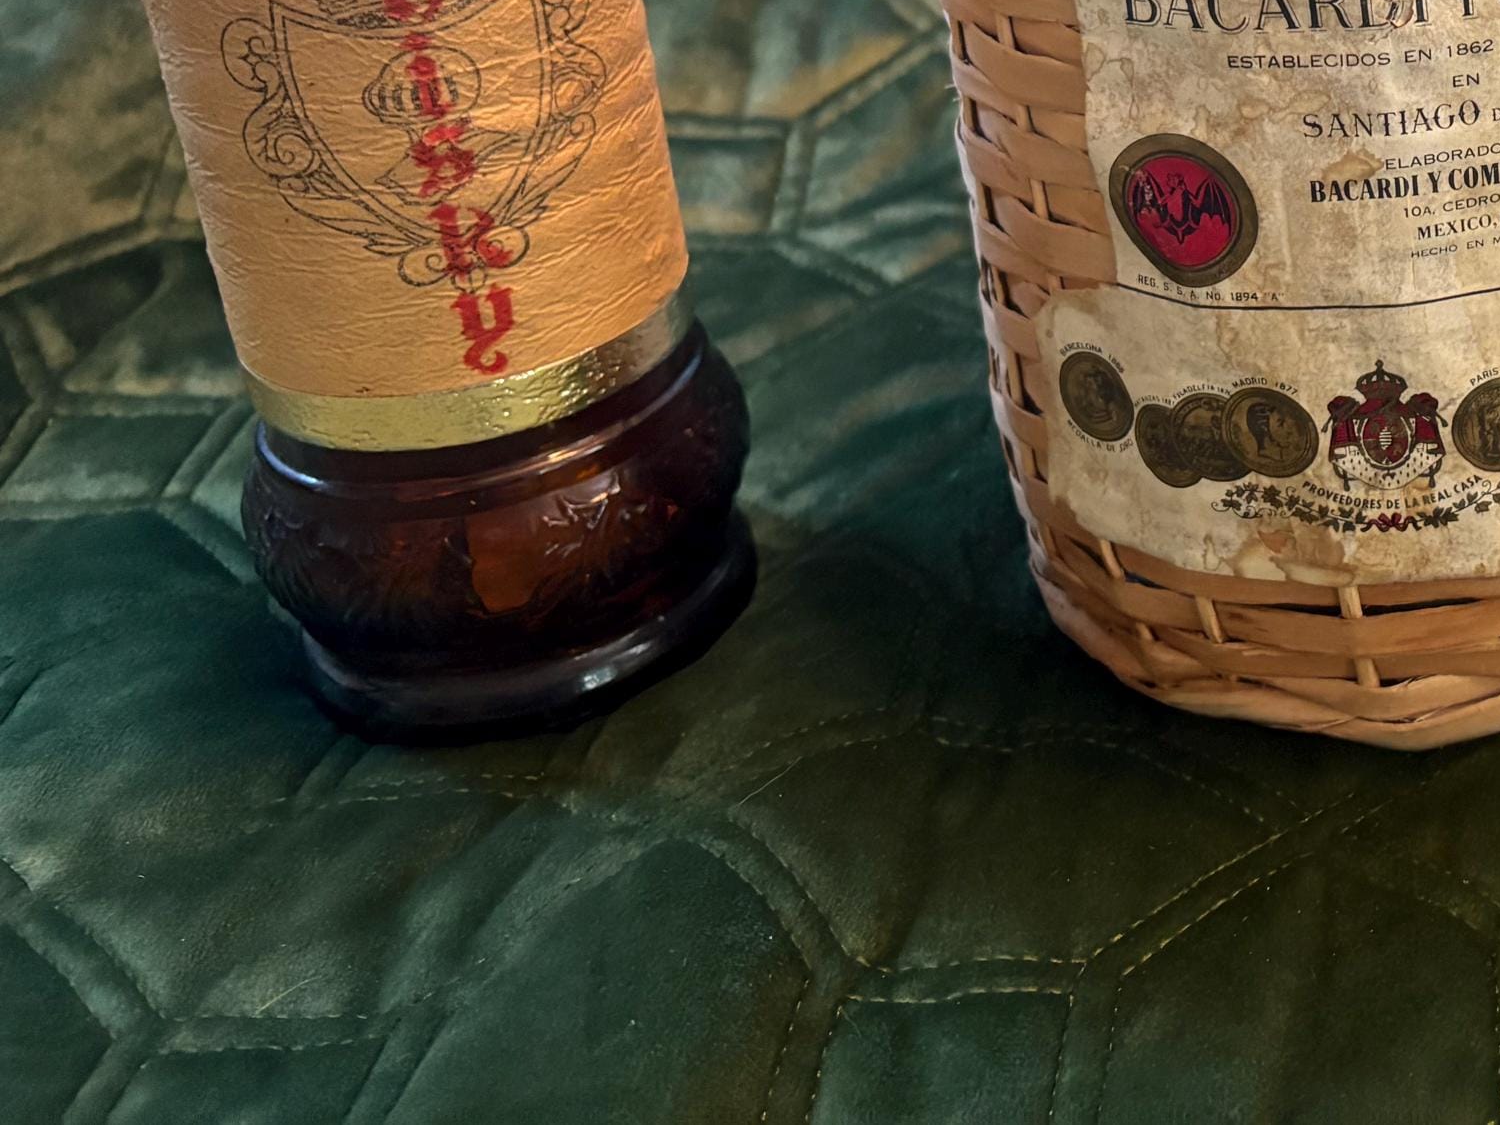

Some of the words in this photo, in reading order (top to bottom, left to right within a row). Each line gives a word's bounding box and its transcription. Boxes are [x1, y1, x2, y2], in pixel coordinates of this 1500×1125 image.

[1227, 51, 1392, 70] ESTABLECIDOS
[1404, 47, 1435, 65] EN
[1446, 39, 1496, 58] 1862
[1452, 73, 1482, 89] EN
[1302, 99, 1481, 139] SANTIAGO
[1309, 174, 1419, 204] BACARDI
[1427, 170, 1442, 194] Y
[1417, 213, 1498, 241] MEXICO,
[1410, 243, 1459, 259] HECHO
[1466, 239, 1485, 251] EN
[1230, 291, 1258, 303] 1894
[1232, 377, 1268, 390] MADRID
[1275, 382, 1299, 396] 1877
[1469, 366, 1499, 386] PARIS
[1302, 480, 1382, 510] PROVEEDORES
[1386, 499, 1400, 510] DE
[1405, 497, 1419, 509] LA
[1423, 488, 1451, 505] REAL
[1453, 474, 1484, 494] CASA
